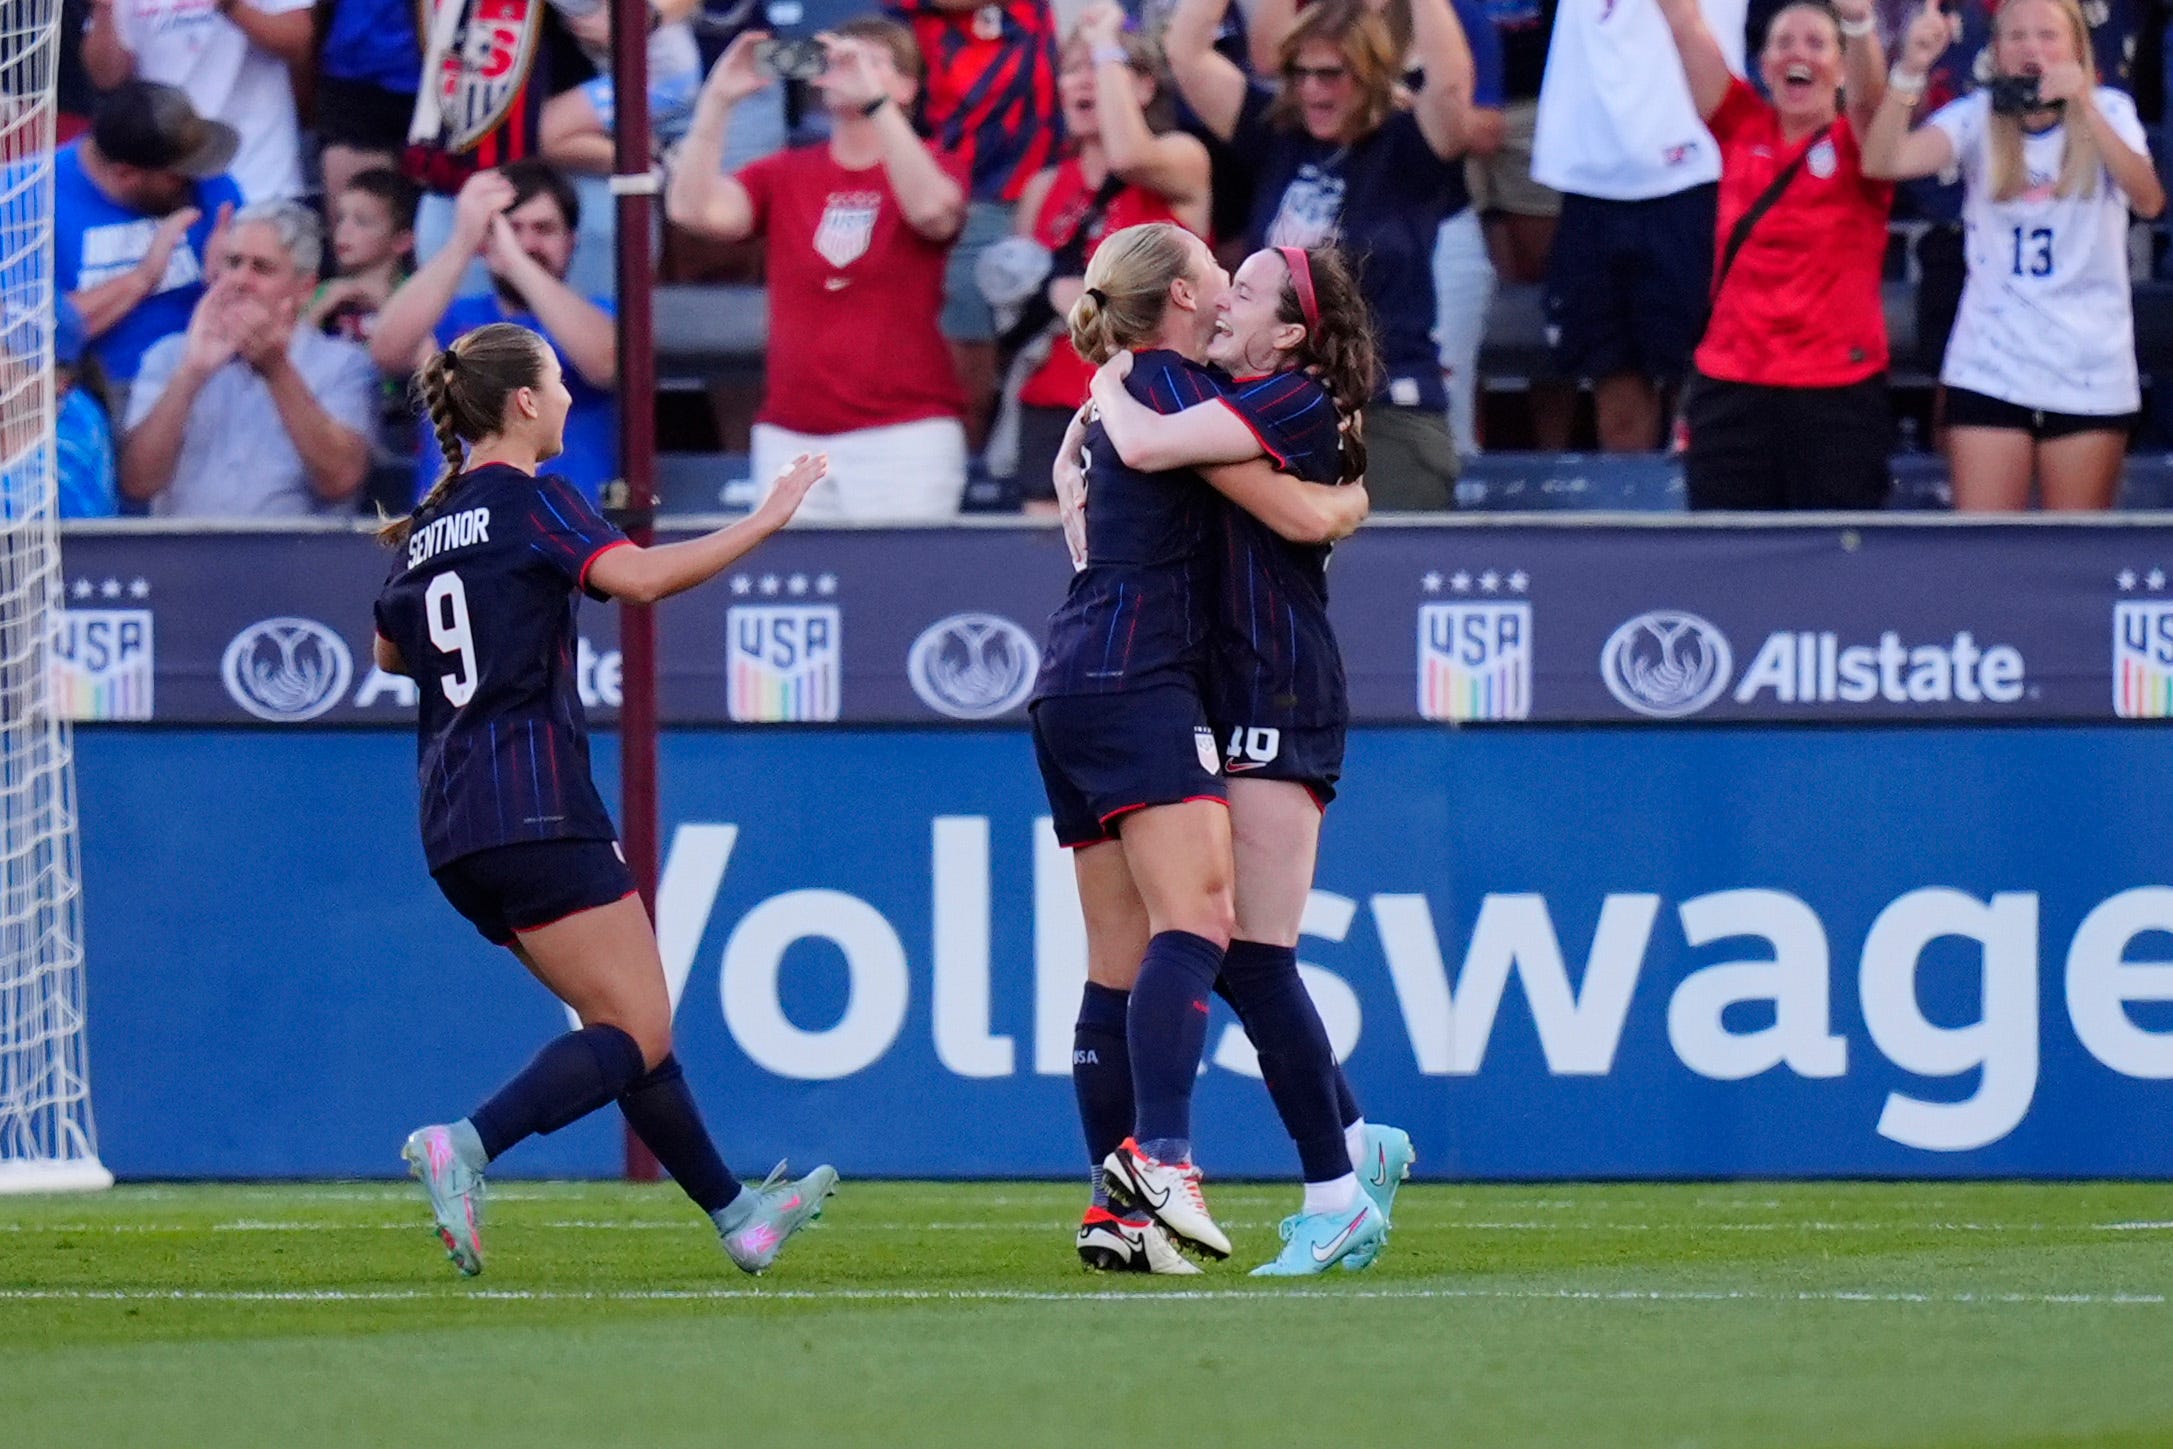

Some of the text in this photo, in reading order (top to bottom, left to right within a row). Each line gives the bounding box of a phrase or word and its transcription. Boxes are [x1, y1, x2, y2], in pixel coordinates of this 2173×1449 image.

[2012, 226, 2053, 276] 13
[407, 506, 490, 569] SENTNOR
[425, 570, 478, 708] 9
[740, 616, 829, 669] USA
[1430, 614, 1520, 666] USA
[1734, 630, 2025, 702] Allstate
[1226, 725, 1280, 762] 10
